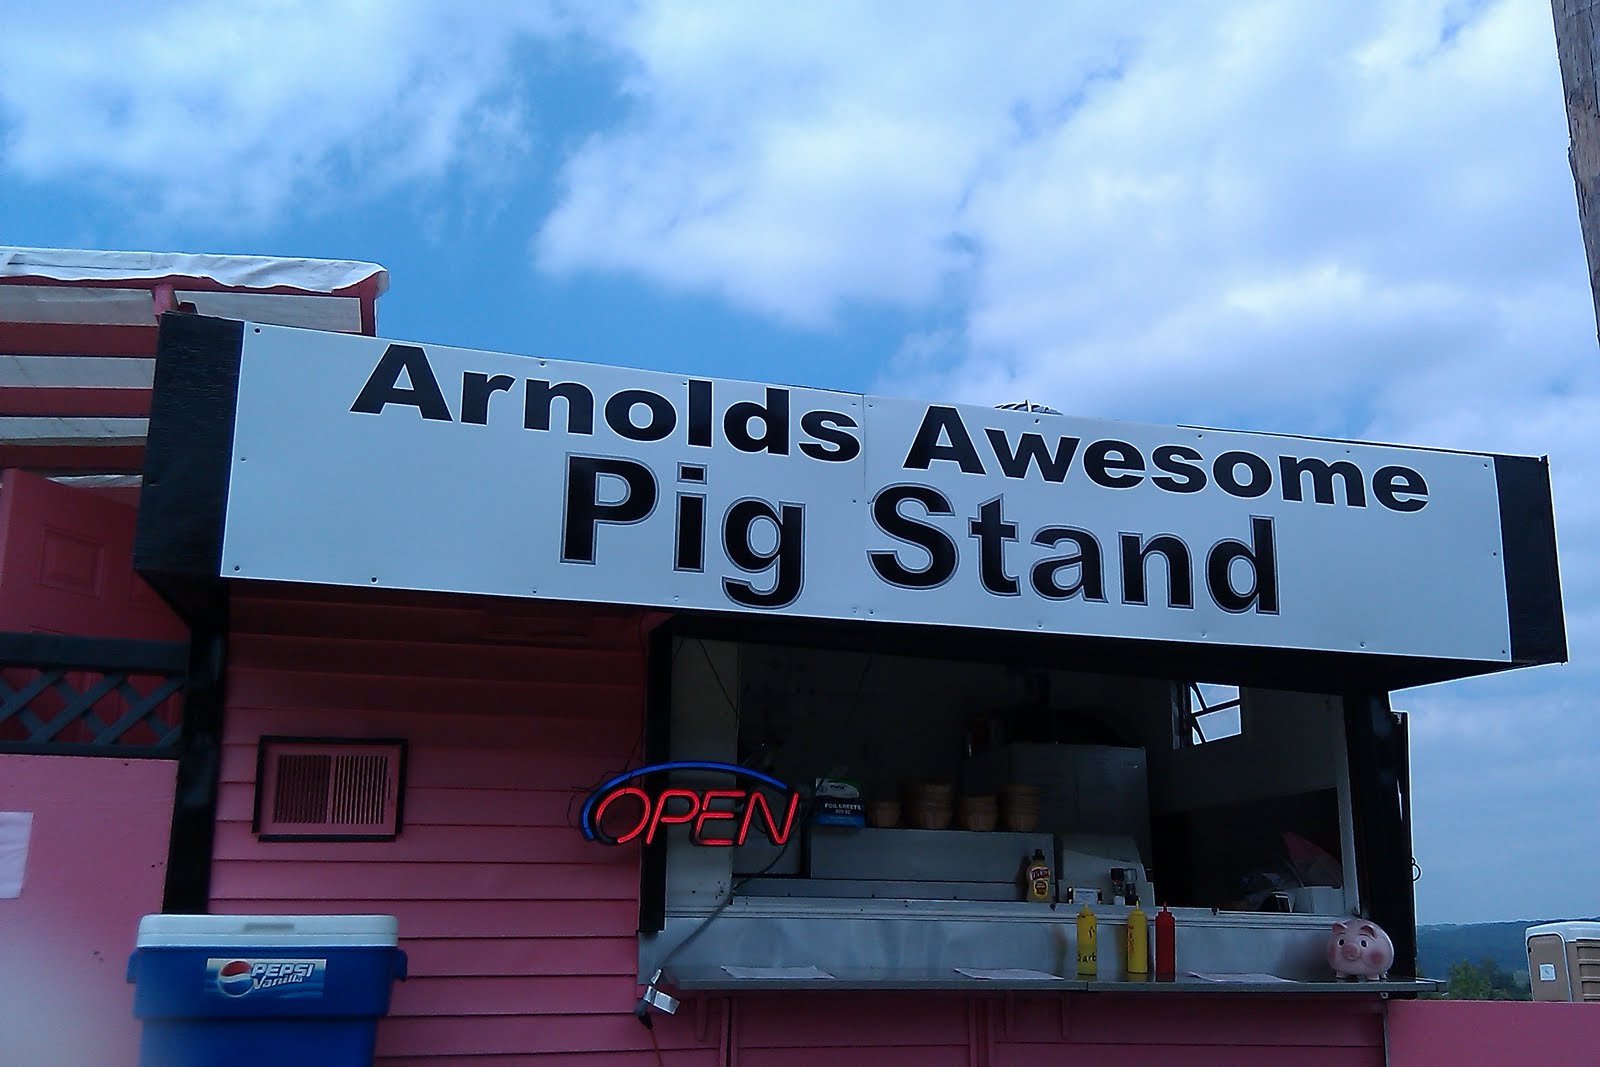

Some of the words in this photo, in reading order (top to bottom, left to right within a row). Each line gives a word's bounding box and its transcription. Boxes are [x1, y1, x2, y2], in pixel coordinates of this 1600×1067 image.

[349, 343, 863, 463] Arnolds
[902, 404, 1430, 513] Awesome
[559, 452, 806, 609] Pig
[866, 481, 1280, 616] Stand
[594, 786, 800, 846] OPEN
[251, 963, 315, 977] PEPSI
[252, 974, 304, 990] Vanilla
